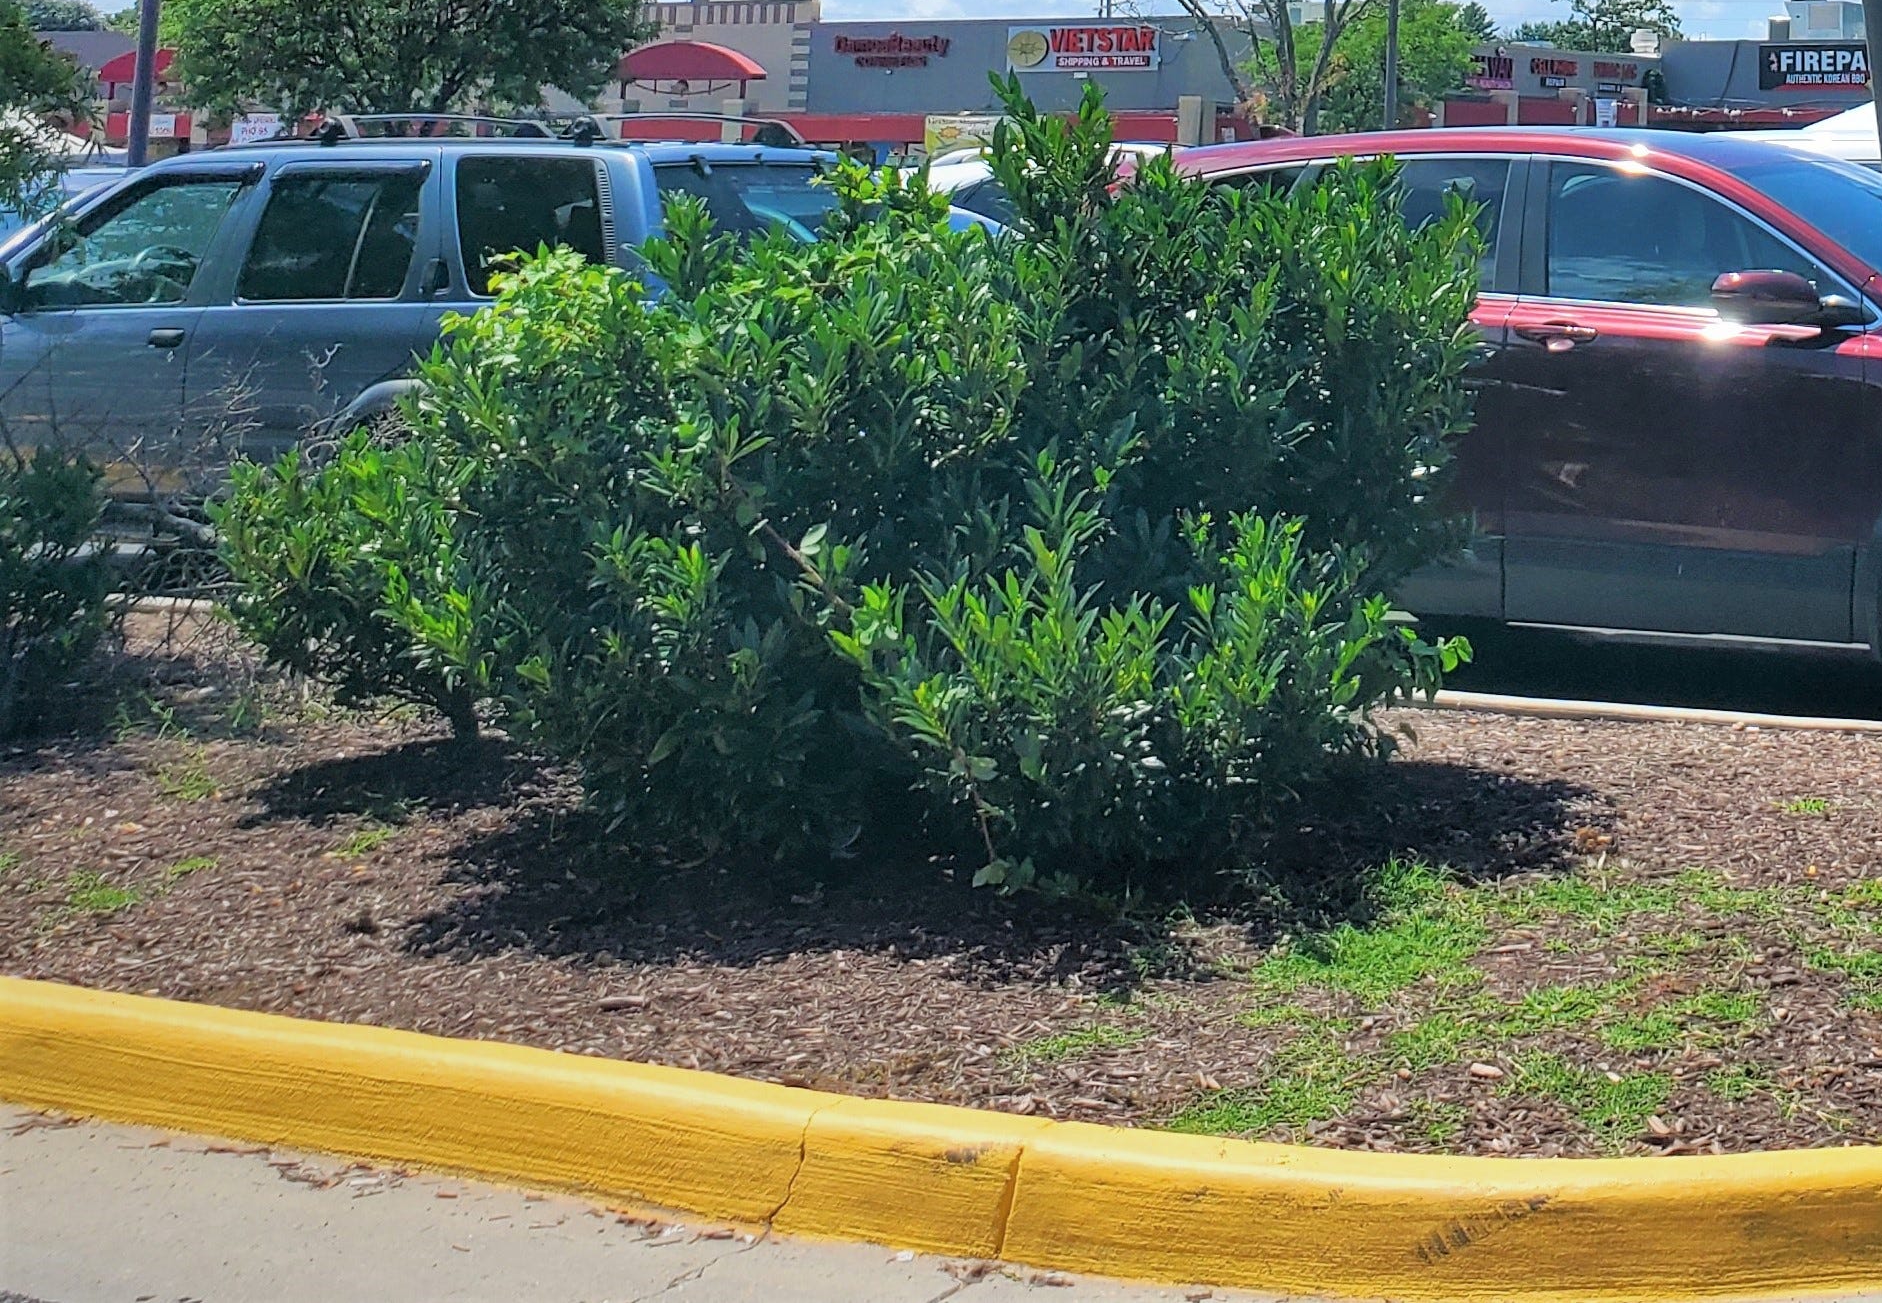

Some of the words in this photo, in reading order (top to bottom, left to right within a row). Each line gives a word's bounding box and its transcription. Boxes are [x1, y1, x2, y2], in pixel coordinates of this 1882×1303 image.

[1050, 26, 1156, 53] VIETSTAR
[1058, 56, 1099, 67] SHIPPING
[1101, 56, 1110, 66] &
[1112, 55, 1147, 66] TRAVEL
[1786, 73, 1822, 84] AUTHENTIC
[1823, 73, 1850, 84] KOREAN
